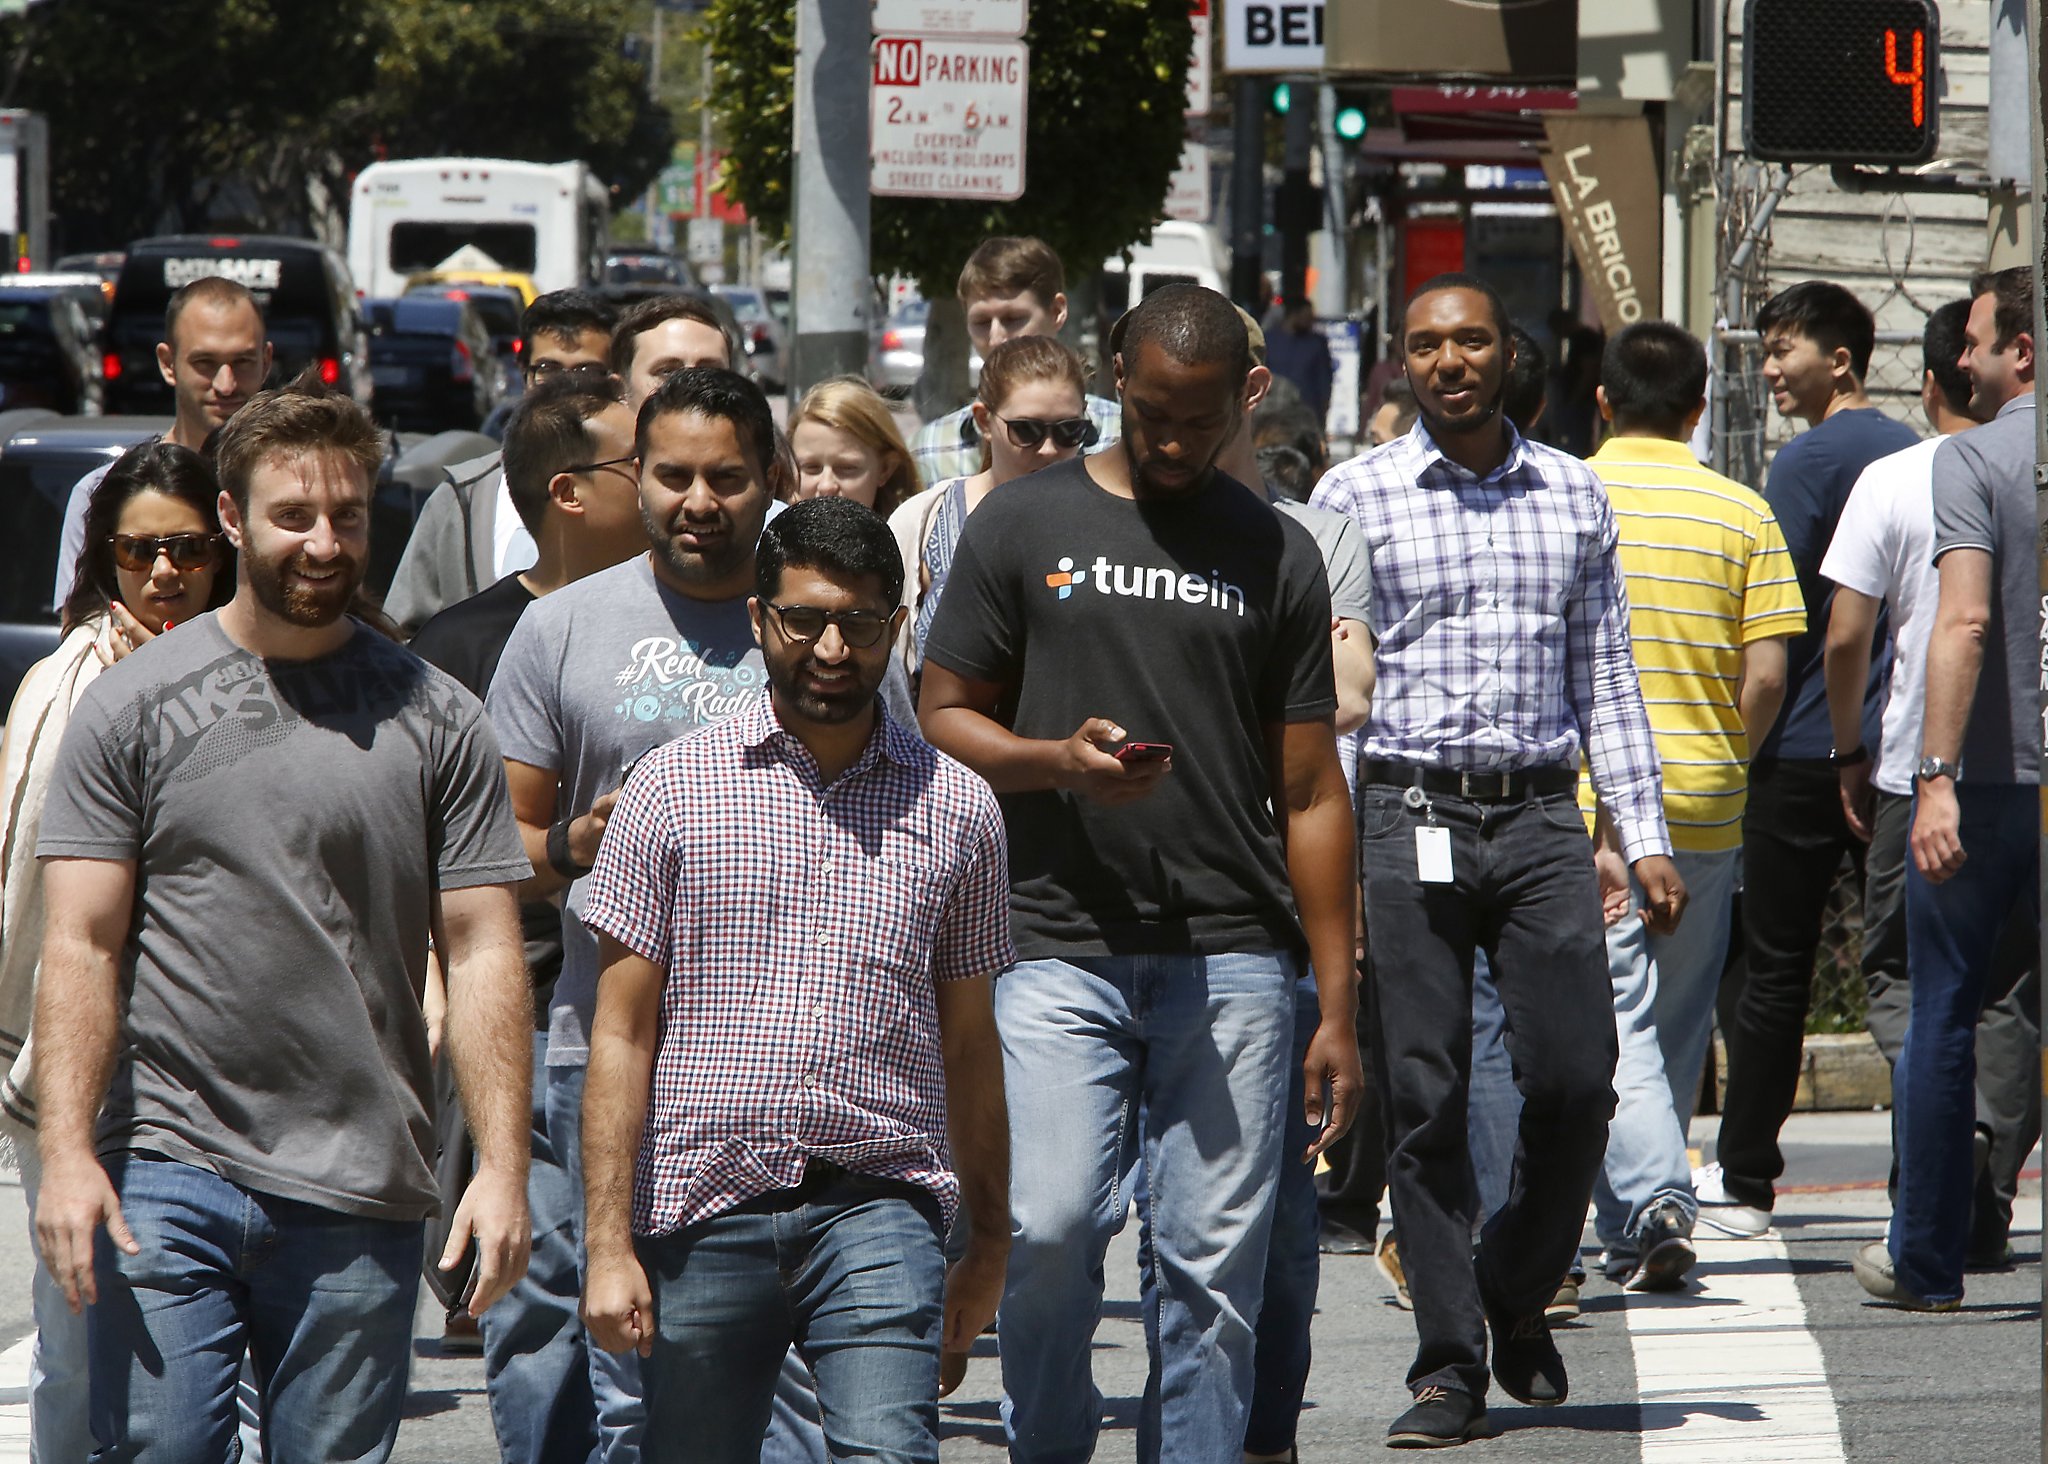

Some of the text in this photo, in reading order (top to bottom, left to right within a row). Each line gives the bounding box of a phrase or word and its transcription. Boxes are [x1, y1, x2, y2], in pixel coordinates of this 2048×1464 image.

[878, 42, 1019, 84] NO PARKING
[1885, 28, 1924, 128] 4
[887, 96, 903, 124] 2
[965, 100, 981, 130] 6
[875, 150, 1016, 169] INCLUDING HOLIDAYS
[914, 132, 980, 149] EVERYDAY
[888, 171, 1004, 190] STREET CLEANING
[1564, 144, 1642, 324] LA BRICIO
[164, 257, 282, 289] DATASAFE
[1091, 556, 1245, 617] tunein
[614, 636, 713, 687] #Real
